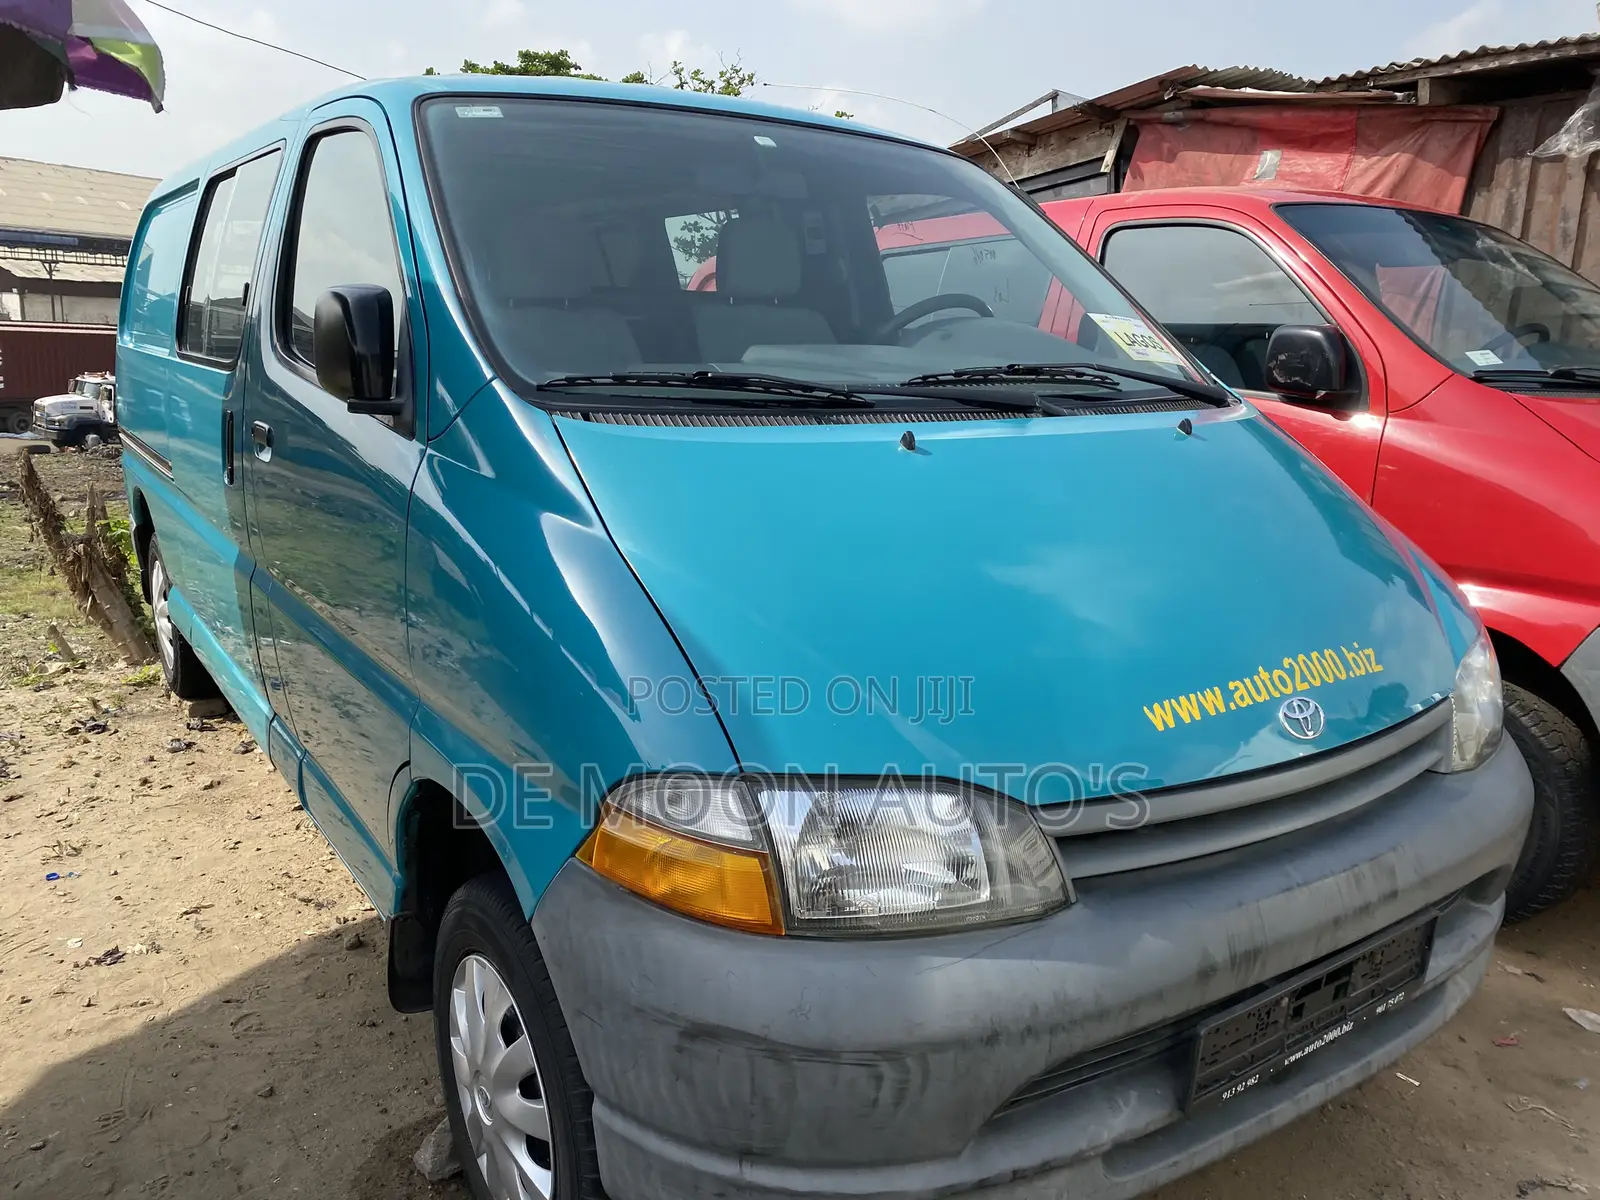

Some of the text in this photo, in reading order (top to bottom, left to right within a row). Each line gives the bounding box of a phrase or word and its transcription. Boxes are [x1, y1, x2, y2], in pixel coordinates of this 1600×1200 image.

[1114, 331, 1165, 351] LAGOS
[1143, 641, 1384, 732] www.auto2000.biz
[1284, 1021, 1354, 1066] www.auto2000.biz
